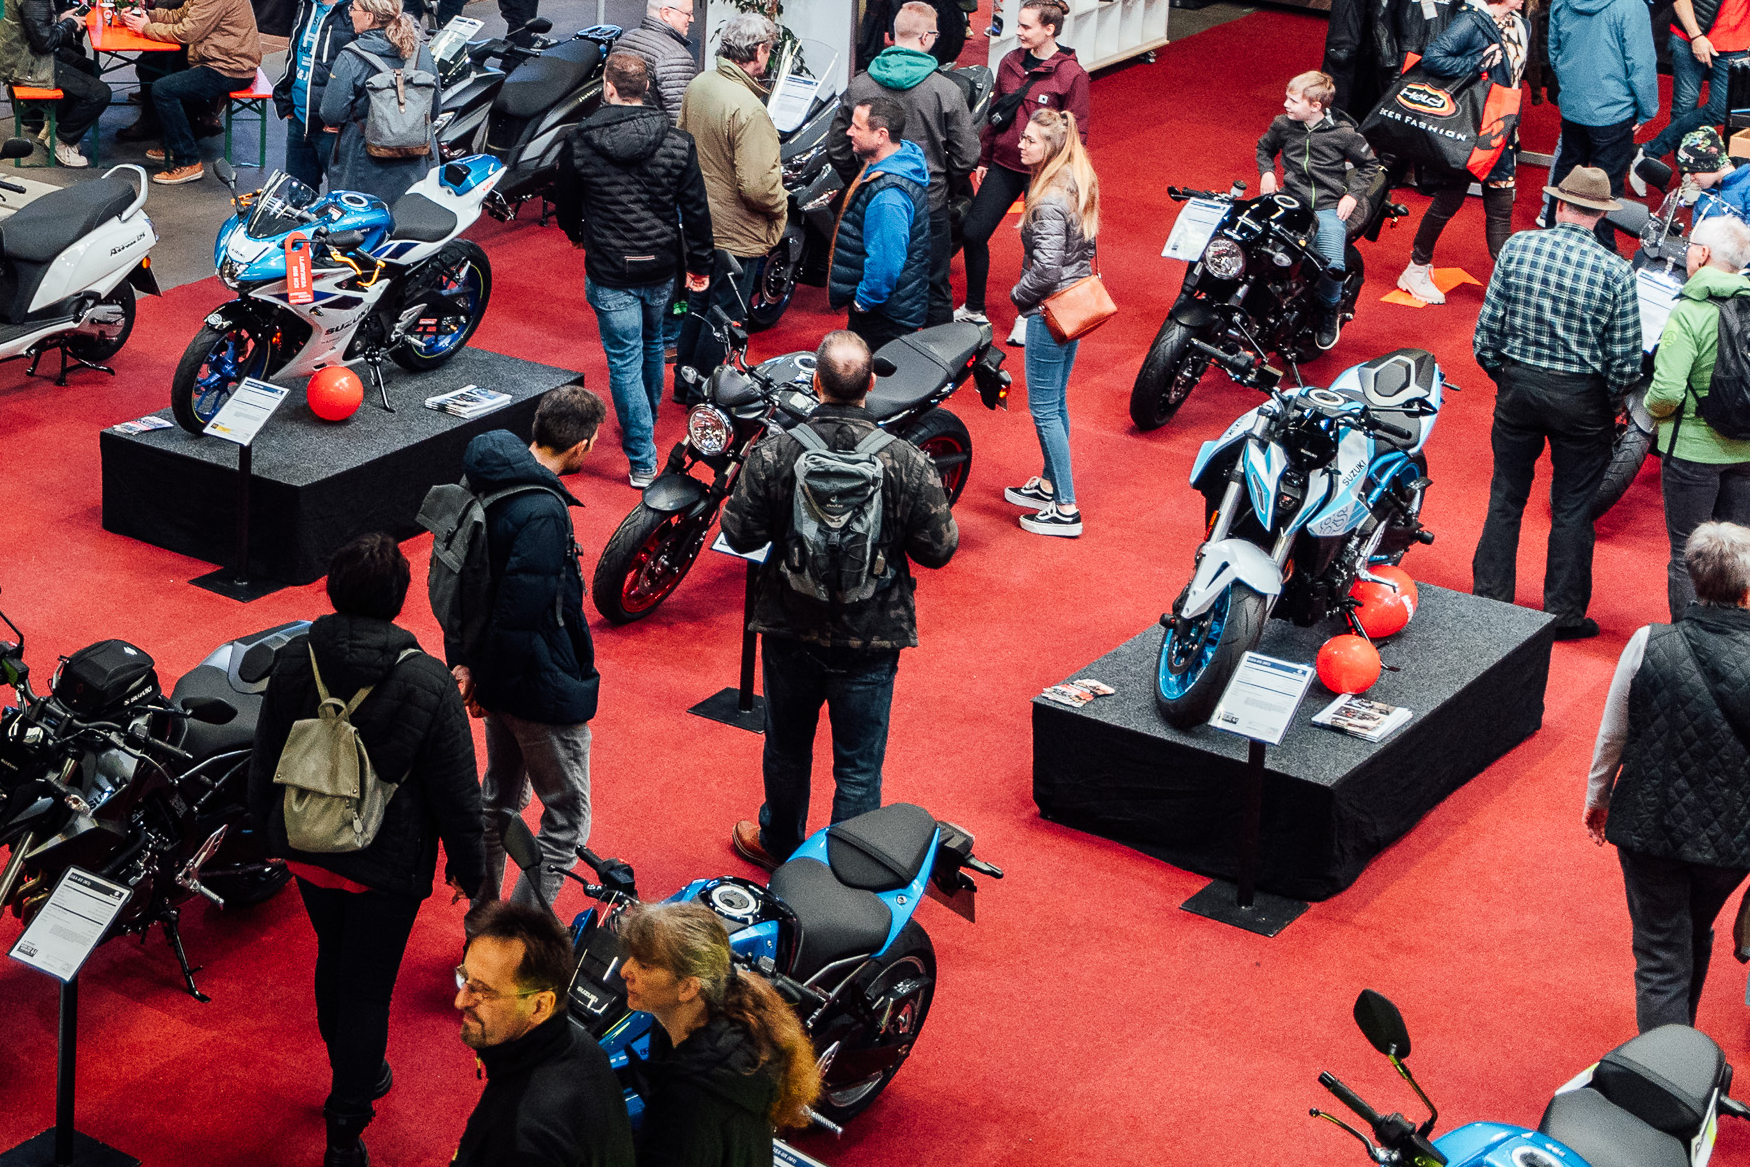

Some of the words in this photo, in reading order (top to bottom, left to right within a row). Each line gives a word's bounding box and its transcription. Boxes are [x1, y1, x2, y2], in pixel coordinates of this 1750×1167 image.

[1404, 115, 1467, 143] FASHION
[325, 304, 372, 337] SUZUKI
[1342, 459, 1367, 487] SUZUKI
[131, 685, 153, 703] SUZUKI
